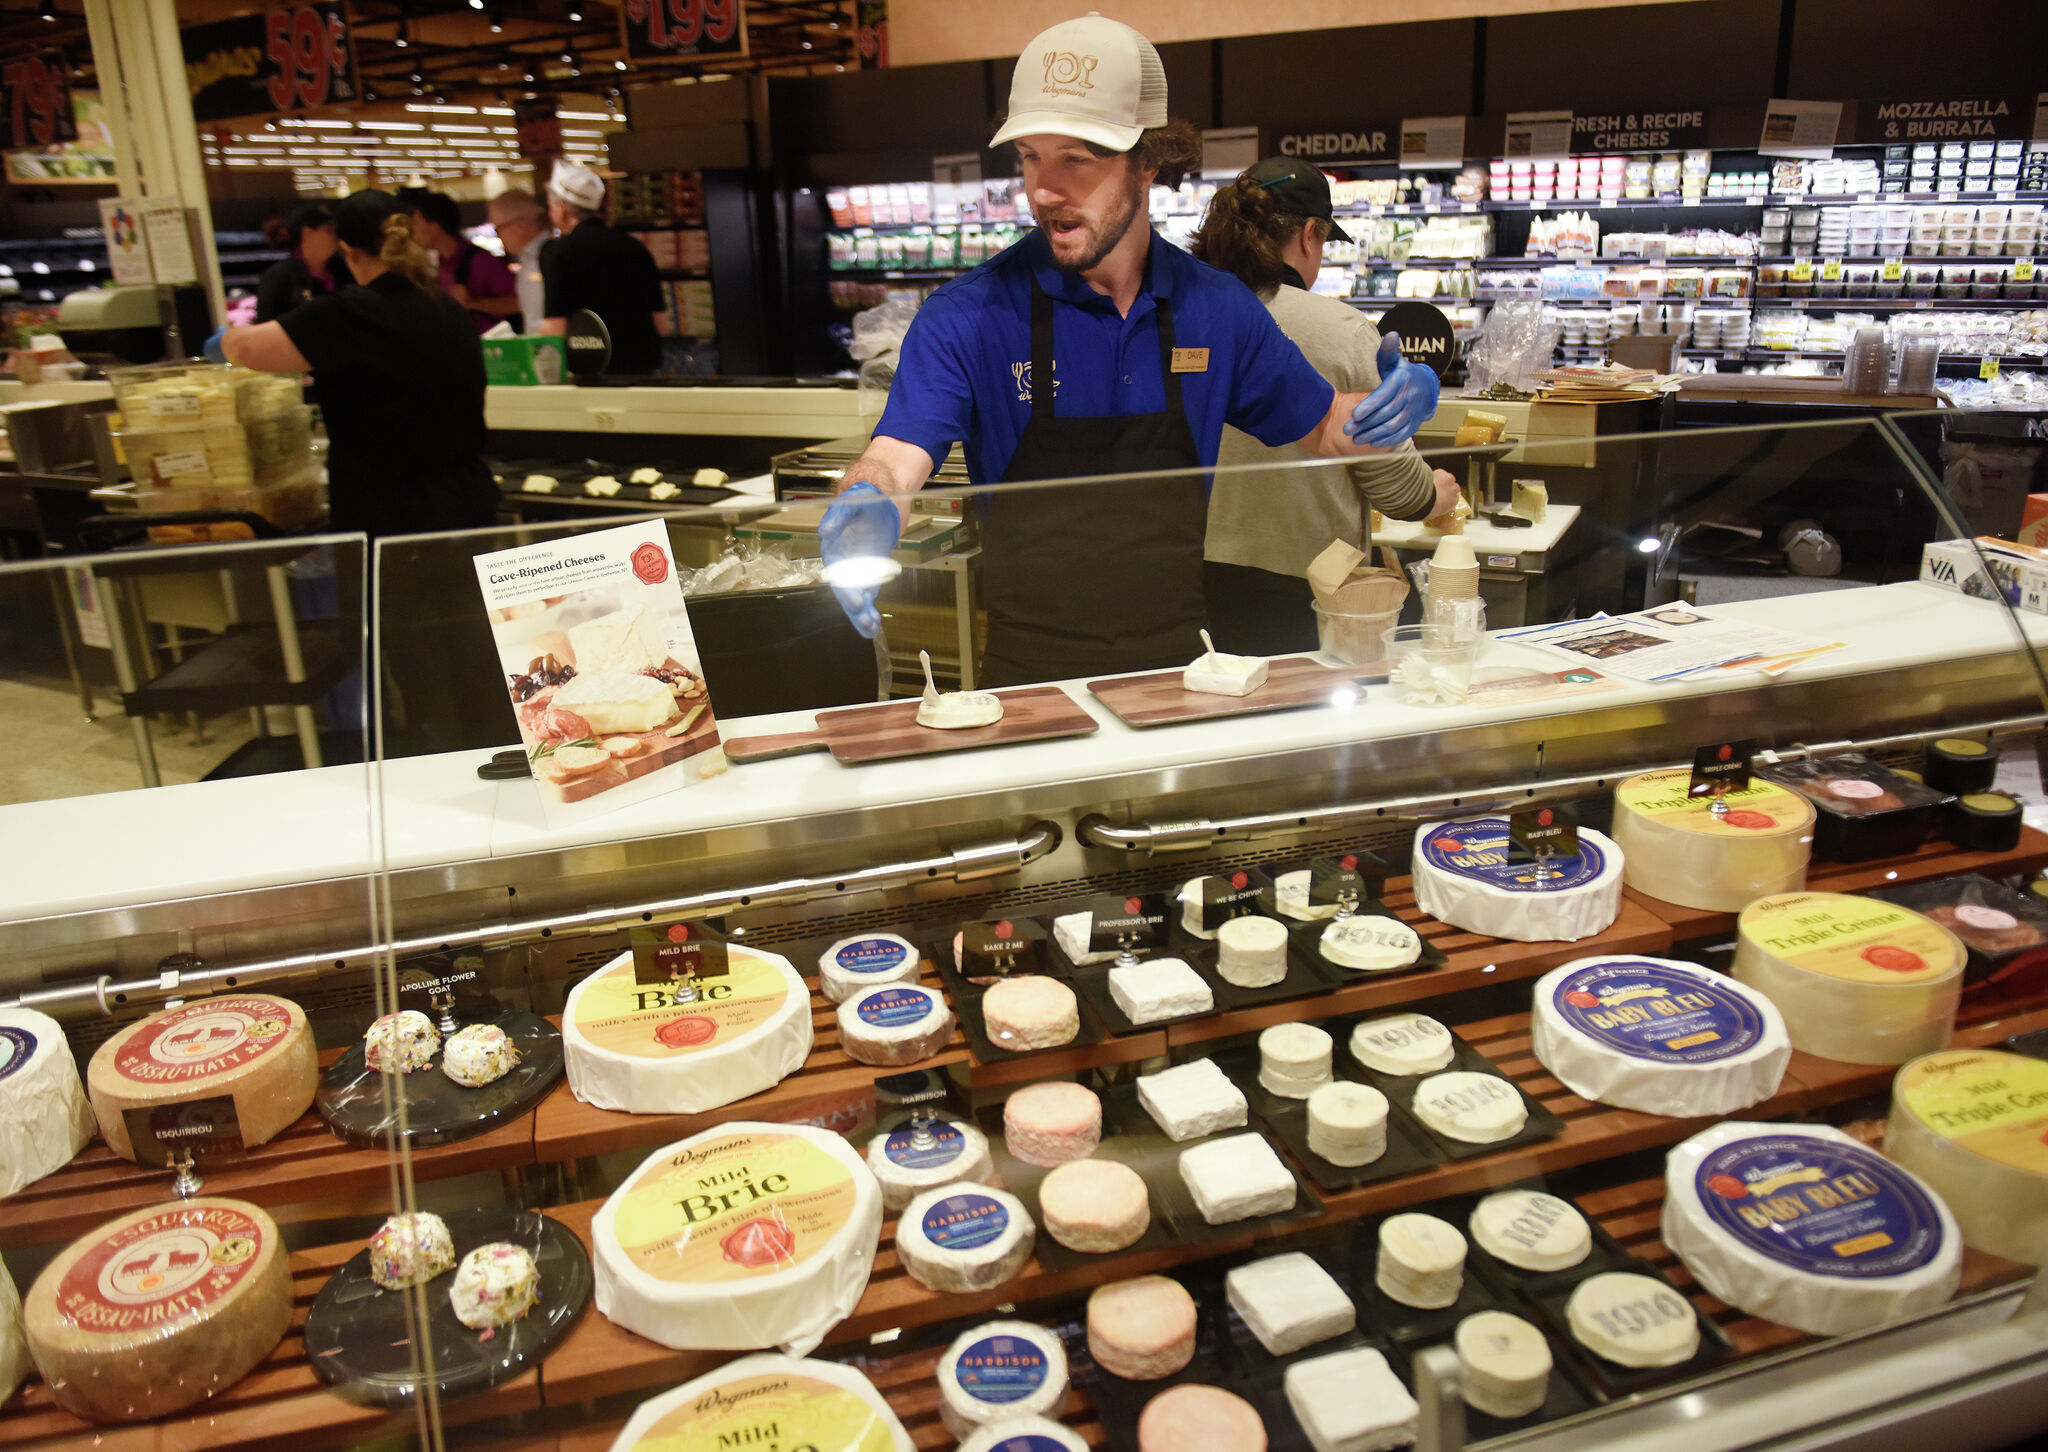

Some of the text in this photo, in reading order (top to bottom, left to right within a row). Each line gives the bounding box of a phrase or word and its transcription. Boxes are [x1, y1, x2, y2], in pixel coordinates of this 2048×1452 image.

[1877, 100, 2009, 119] MOZZARELLA
[1625, 114, 1638, 130] &
[1643, 111, 1703, 130] RECIPE
[1885, 120, 1996, 138] & BURRATA
[1281, 132, 1387, 155] CHEDDAR
[1594, 131, 1670, 148] CHEESES
[1187, 350, 1203, 360] DAVE
[1399, 336, 1445, 353] ALIAN
[486, 552, 553, 570] TASTE THE DIFFERENCE
[489, 552, 606, 585] Cave-Ripened Cheeses
[1930, 558, 1957, 584] VIA
[1527, 828, 1562, 840] BABY BLEU
[1450, 852, 1508, 868] BABY
[984, 943, 1003, 951] SAKE
[1764, 929, 1837, 950] Triple
[659, 944, 700, 957] MILD BRIE
[400, 971, 476, 992] APOLLINE FLOWER
[429, 985, 450, 995] GOAT
[1587, 992, 1716, 1029] BABY BLEU
[130, 1050, 241, 1081] OSSAU-IRATY
[902, 1089, 947, 1104] HARBISON
[156, 1124, 213, 1139] ESQUIRROU
[672, 1137, 752, 1167] Wegmans
[697, 1166, 750, 1190] Mild
[673, 1174, 790, 1226] Brie
[1738, 1193, 1811, 1229] BABY
[1805, 1171, 1880, 1208] BLEU
[928, 1204, 998, 1228] HARBISON
[107, 1208, 249, 1247] ESQUIRROU
[75, 1286, 207, 1328] OSSAU-IRATY
[964, 1356, 1040, 1367] HARBISON
[695, 1380, 789, 1413] Wegmans
[718, 1422, 780, 1449] Mild
